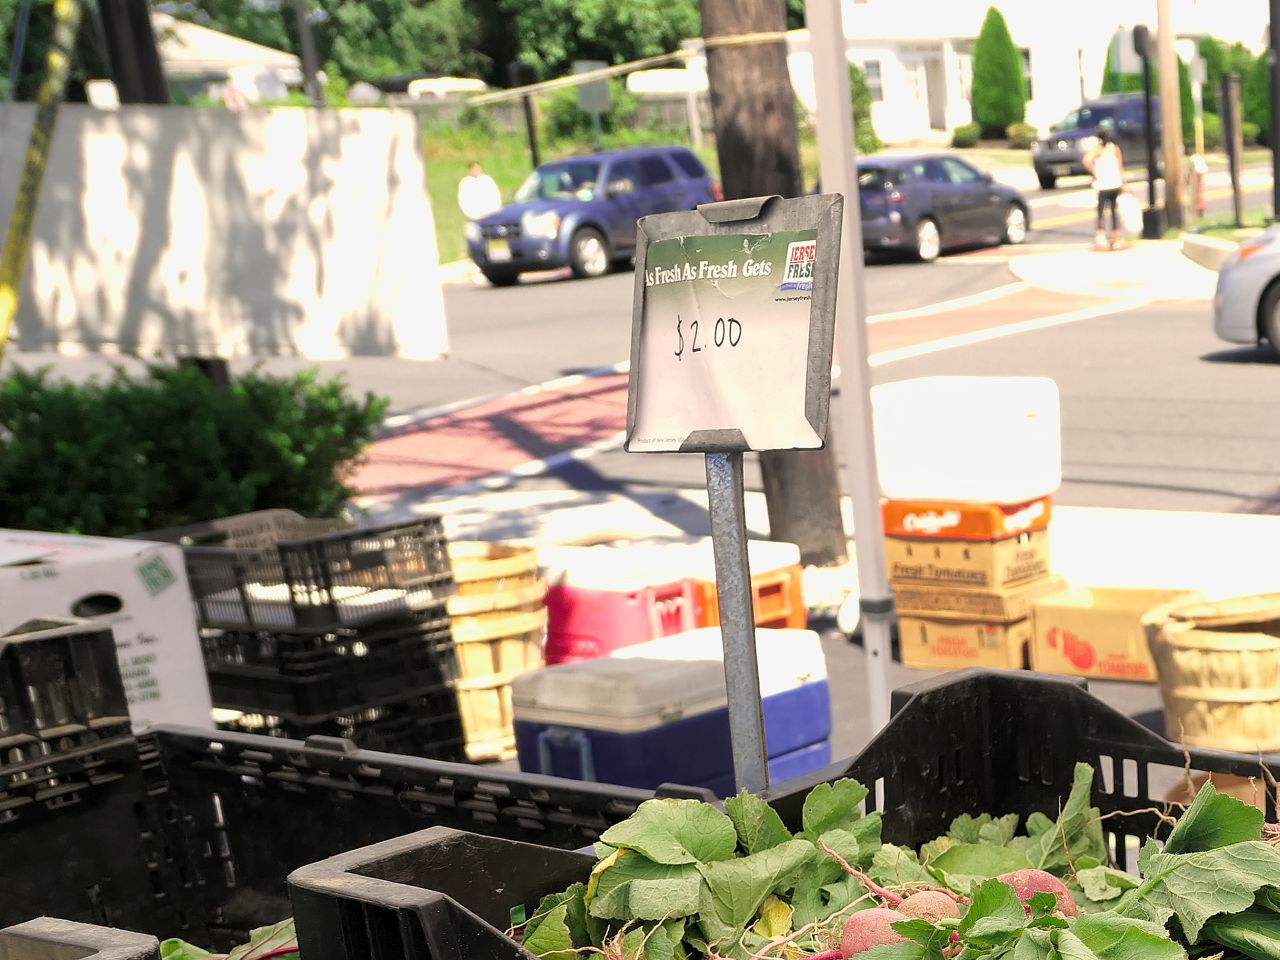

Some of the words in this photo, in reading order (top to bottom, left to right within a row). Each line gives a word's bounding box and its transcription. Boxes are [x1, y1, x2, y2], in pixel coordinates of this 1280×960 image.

[791, 245, 816, 261] JERSE
[655, 264, 681, 285] Fresh
[682, 262, 697, 280] As
[698, 260, 738, 279] Fresh
[742, 259, 772, 277] Gets
[674, 313, 742, 361] $2.00
